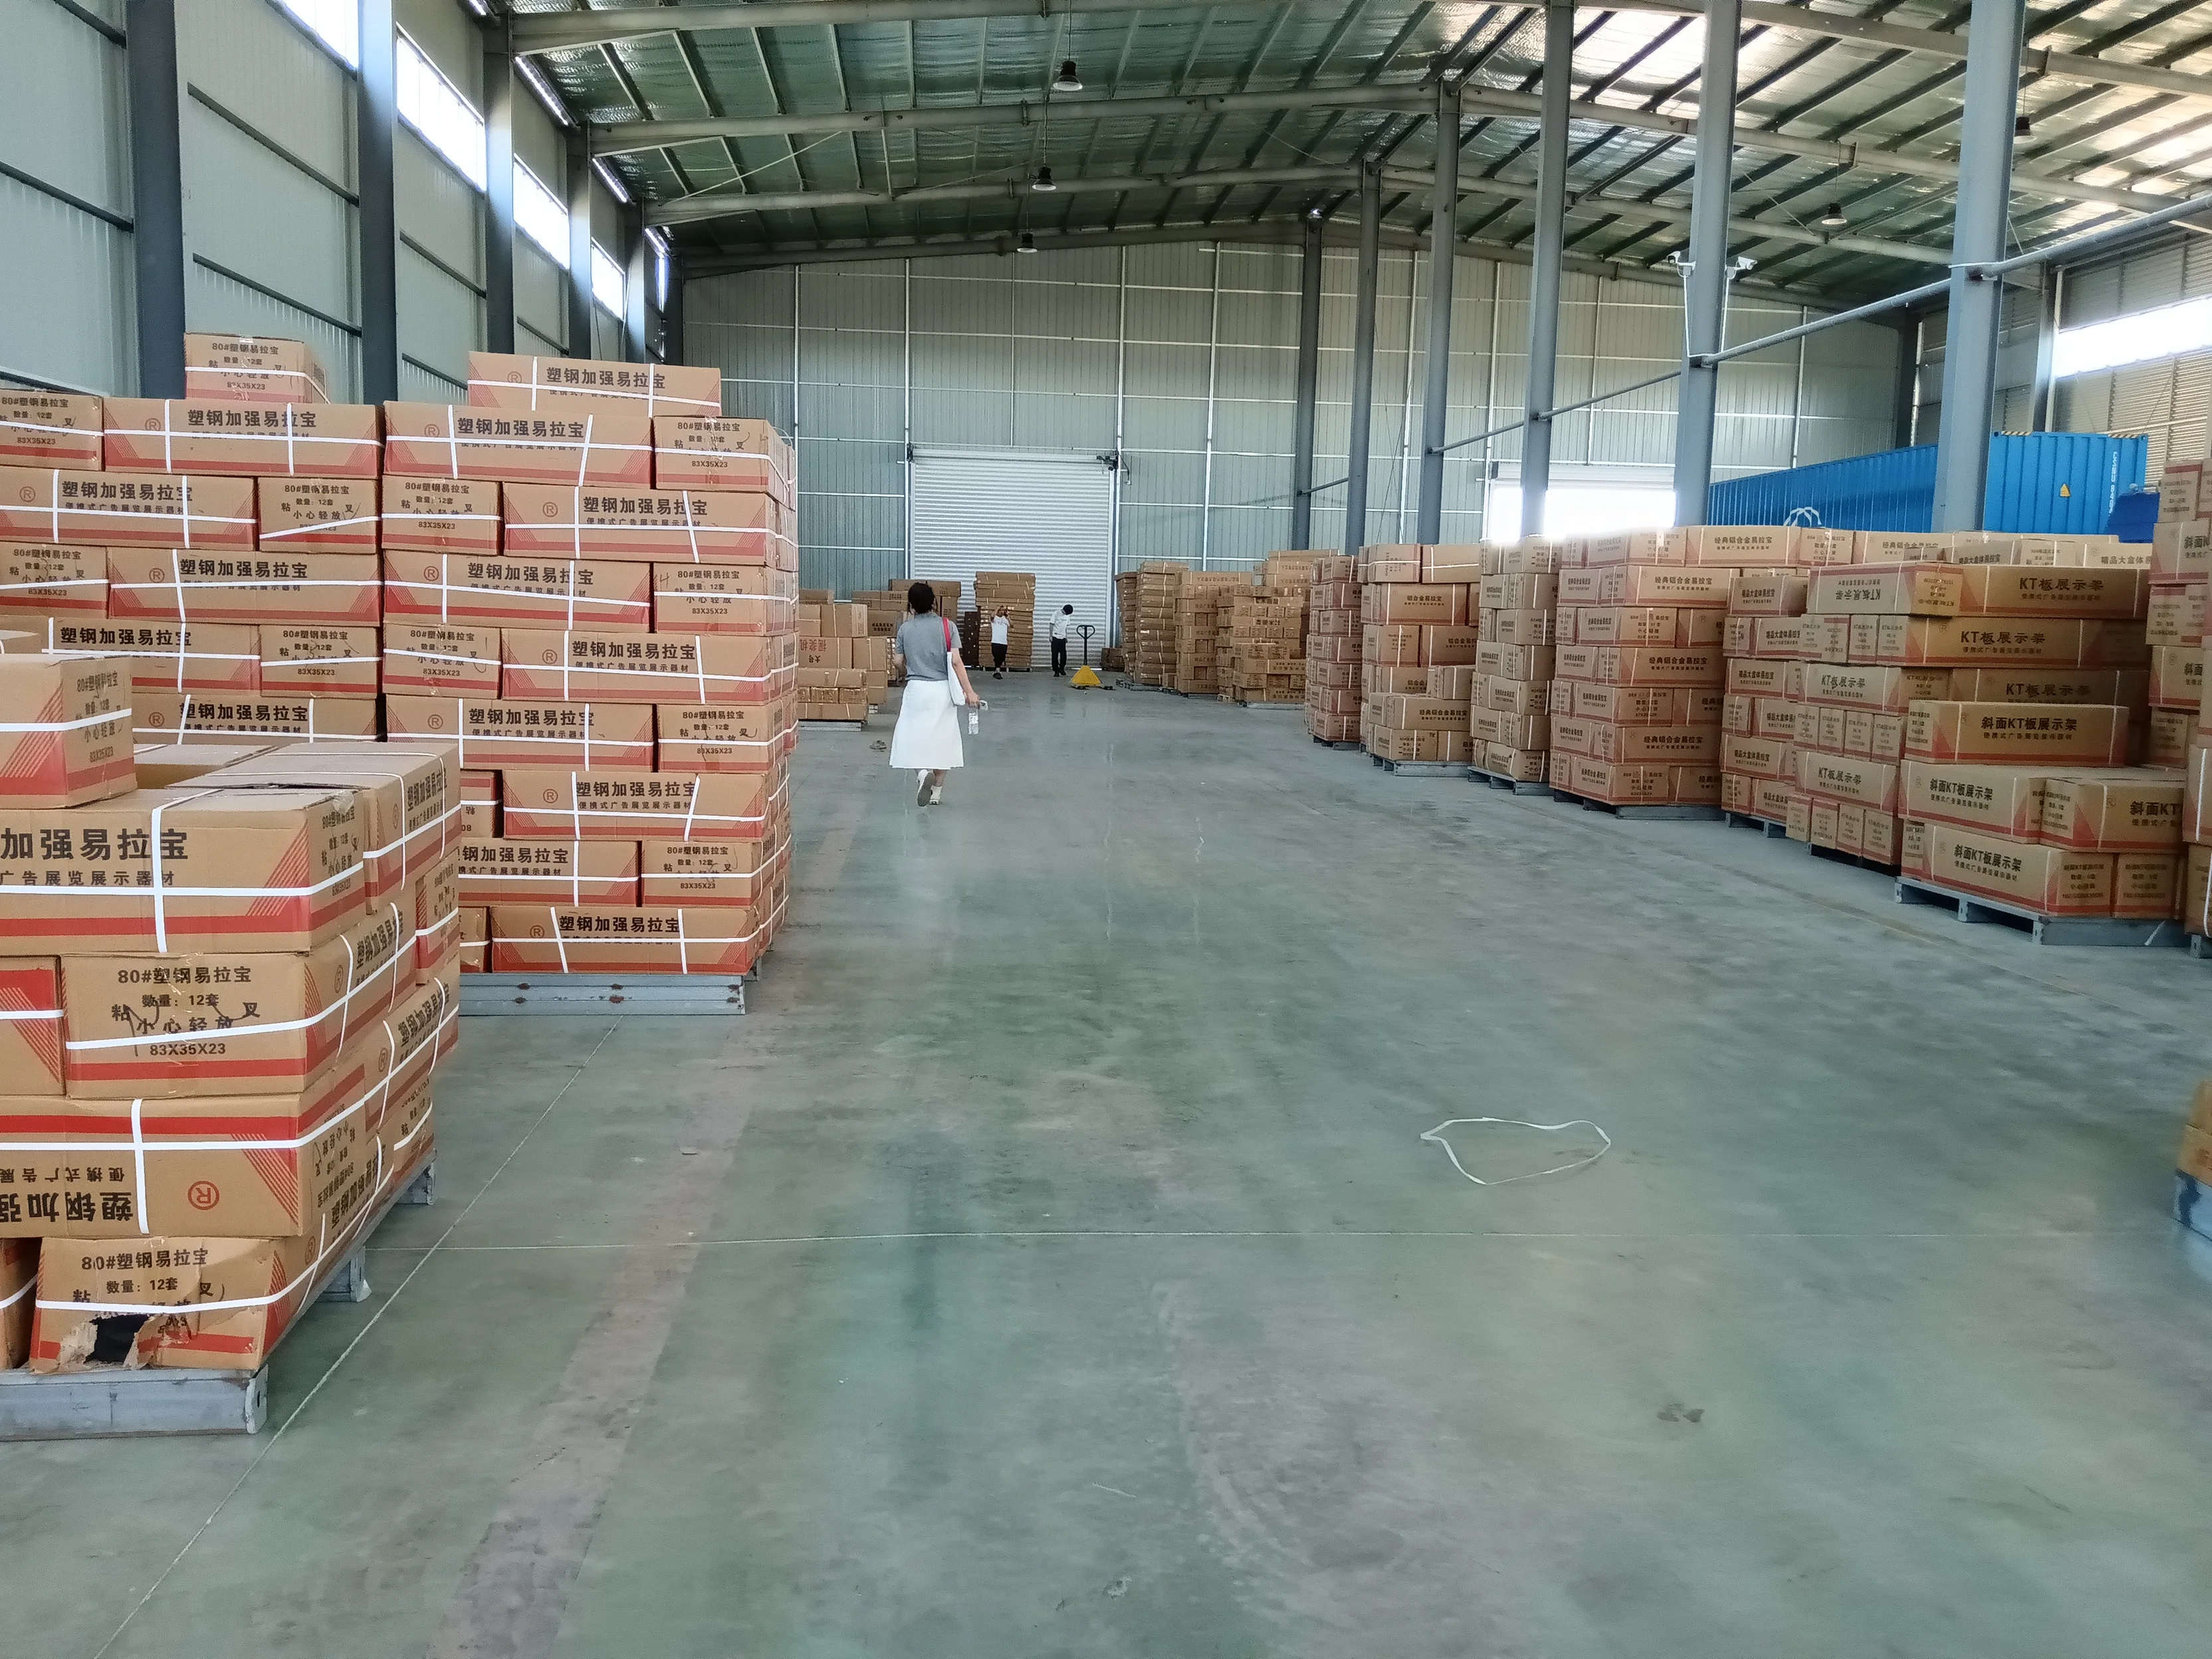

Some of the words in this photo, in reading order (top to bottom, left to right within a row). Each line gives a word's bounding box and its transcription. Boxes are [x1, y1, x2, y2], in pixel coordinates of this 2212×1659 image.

[212, 342, 278, 355] 80#塑钢易拉宝
[546, 367, 665, 388] 塑钢加强易拉宝
[187, 409, 316, 428] 塑钢加强易拉宝
[457, 417, 584, 438] 塑钢加强易拉宝
[677, 421, 740, 432] 80#塑钢易拉宝
[17, 437, 56, 445] 83X35X23
[674, 439, 683, 449] 粘
[62, 481, 193, 501] 塑钢加强易拉宝
[284, 485, 350, 495] 80#塑钢易拉宝
[405, 482, 469, 494] 80#塑钢易拉宝
[281, 502, 291, 512] 粘
[401, 499, 410, 508] 粘
[584, 497, 707, 516] 塑钢加强易拉宝
[293, 510, 340, 520] 小心轻放
[418, 521, 455, 530] 83X35X23
[13, 549, 81, 560] 80#塑钢易拉宝
[9, 567, 19, 576] 粘
[180, 559, 308, 578] 塑钢加强易拉宝
[467, 562, 594, 585] 塑钢加强易拉宝
[678, 570, 740, 580] 80#塑钢易拉宝
[1654, 576, 1713, 585] 经典铝合金易拉宝
[2019, 578, 2104, 592] KT板展示架
[60, 627, 191, 646] 塑钢加强易拉宝
[283, 630, 348, 640] 80#塑钢易拉宝
[410, 629, 475, 641] 80#塑钢易拉宝
[1961, 631, 2045, 645] KT板展示架
[279, 647, 289, 657] 粘
[572, 641, 696, 660] 塑钢加强易拉宝
[800, 639, 827, 651] 摇奖机
[808, 655, 821, 663] 大号
[1821, 674, 1866, 689] KT板展示架
[2006, 683, 2089, 697] KT板展示架
[179, 703, 308, 722] 塑钢加强易拉宝
[469, 708, 594, 726] 塑钢加强易拉宝
[683, 711, 744, 720] 80#塑钢易拉宝
[1981, 717, 2077, 731] 斜面KT板展示架
[679, 728, 689, 737] 粘
[1643, 735, 1704, 744] 经典铝合金易拉宝
[1818, 767, 1861, 785] KT板展示架
[577, 781, 696, 798] 塑钢加强易拉宝
[1930, 778, 1993, 801] 斜面KT板展示架
[579, 800, 692, 810] 便携式广告展览展示器材
[1, 828, 188, 860] 加强易拉宝
[667, 847, 728, 855] 80#塑钢易拉宝
[457, 845, 568, 864] 钢加强易拉宝
[1954, 844, 2022, 873] 斜面KT板展示架
[663, 863, 673, 872] 粘
[559, 915, 679, 933] 塑钢加强易拉宝
[118, 966, 251, 984] 80#塑钢易拉宝
[142, 993, 219, 1007] 数量：12套
[112, 1004, 130, 1022] 粘
[243, 1002, 261, 1018] 叉
[136, 1016, 233, 1034] 小心轻放
[150, 1043, 226, 1056] 83X35X23
[81, 1248, 209, 1270] 80#塑钢易拉宝
[106, 1277, 177, 1293] 数量：12套
